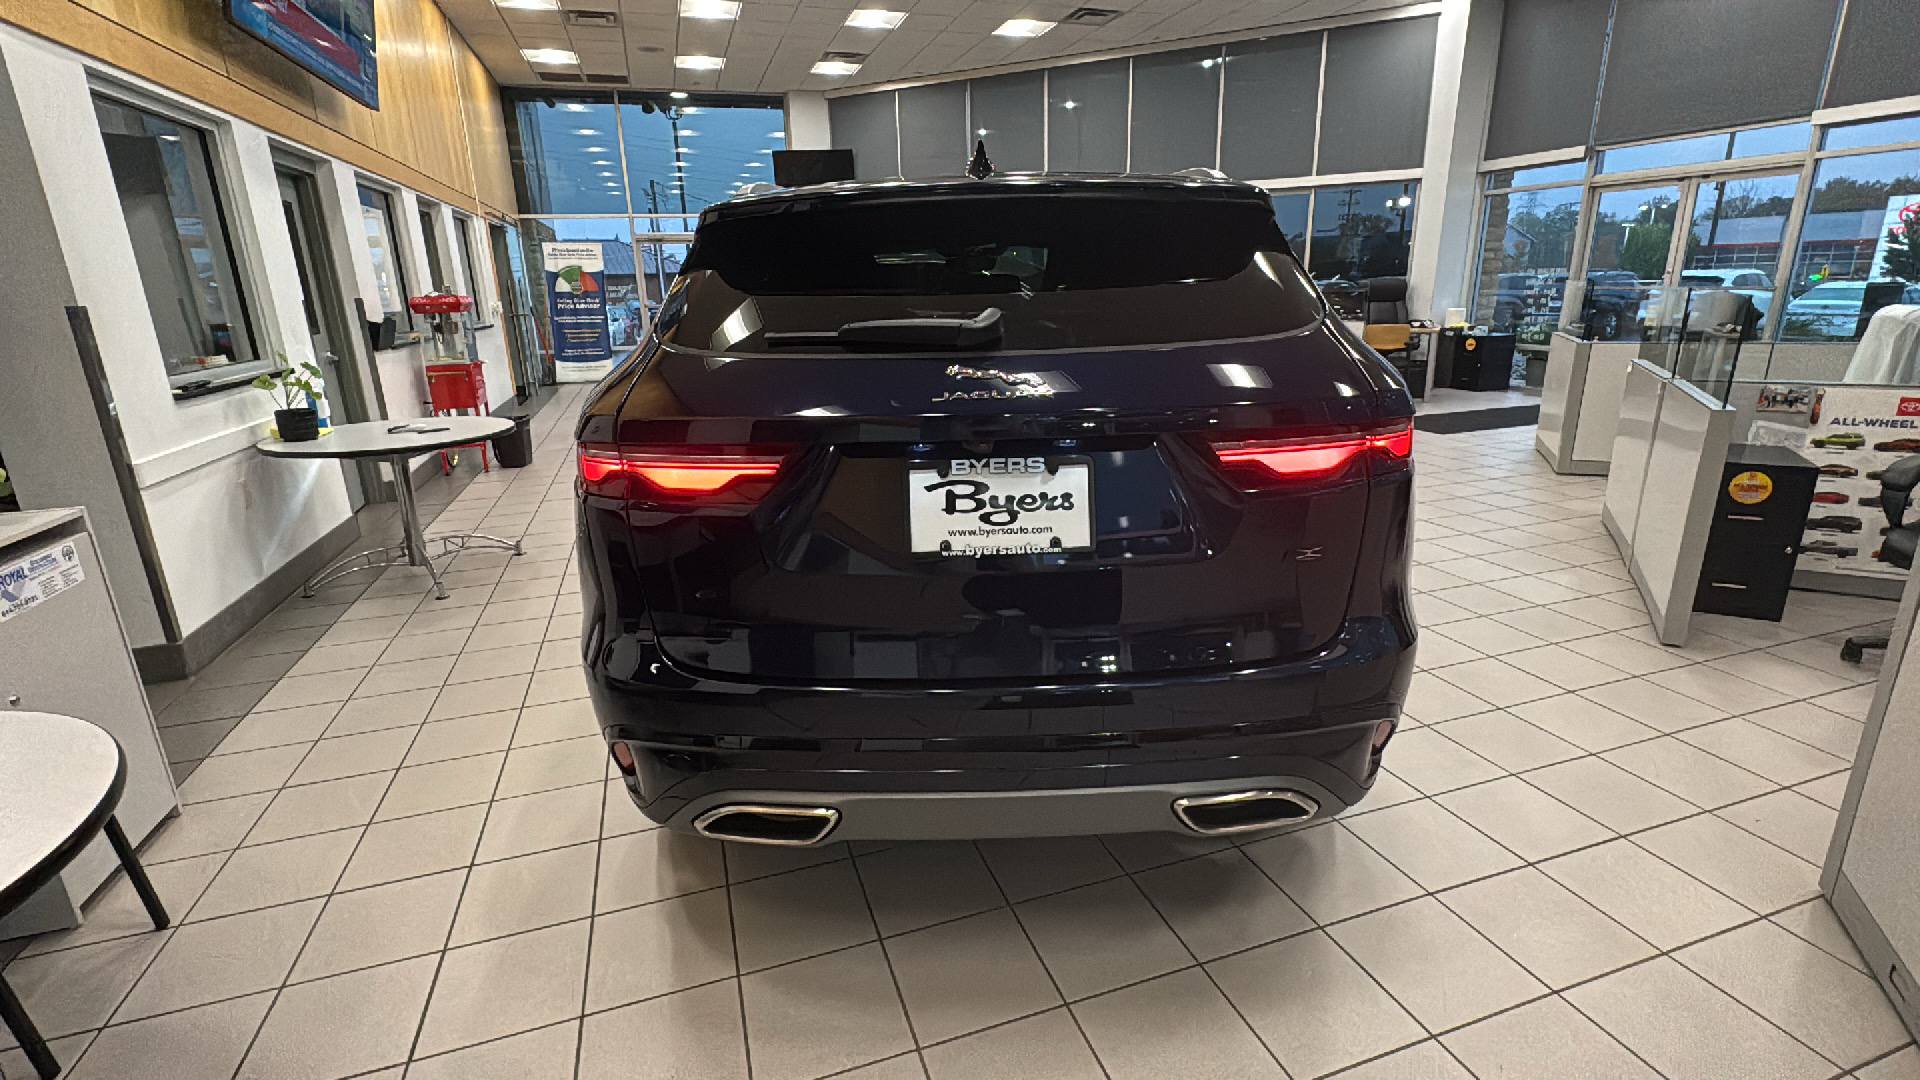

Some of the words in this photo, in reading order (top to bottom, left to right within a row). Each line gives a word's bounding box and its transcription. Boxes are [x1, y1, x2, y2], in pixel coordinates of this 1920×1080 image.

[1829, 417, 1918, 429] ALL-WHEEL
[951, 457, 1045, 475] BYERS
[924, 479, 1075, 526] Byers
[948, 525, 1053, 538] www.byersauto.com
[942, 543, 1062, 558] www.byersauto.com
